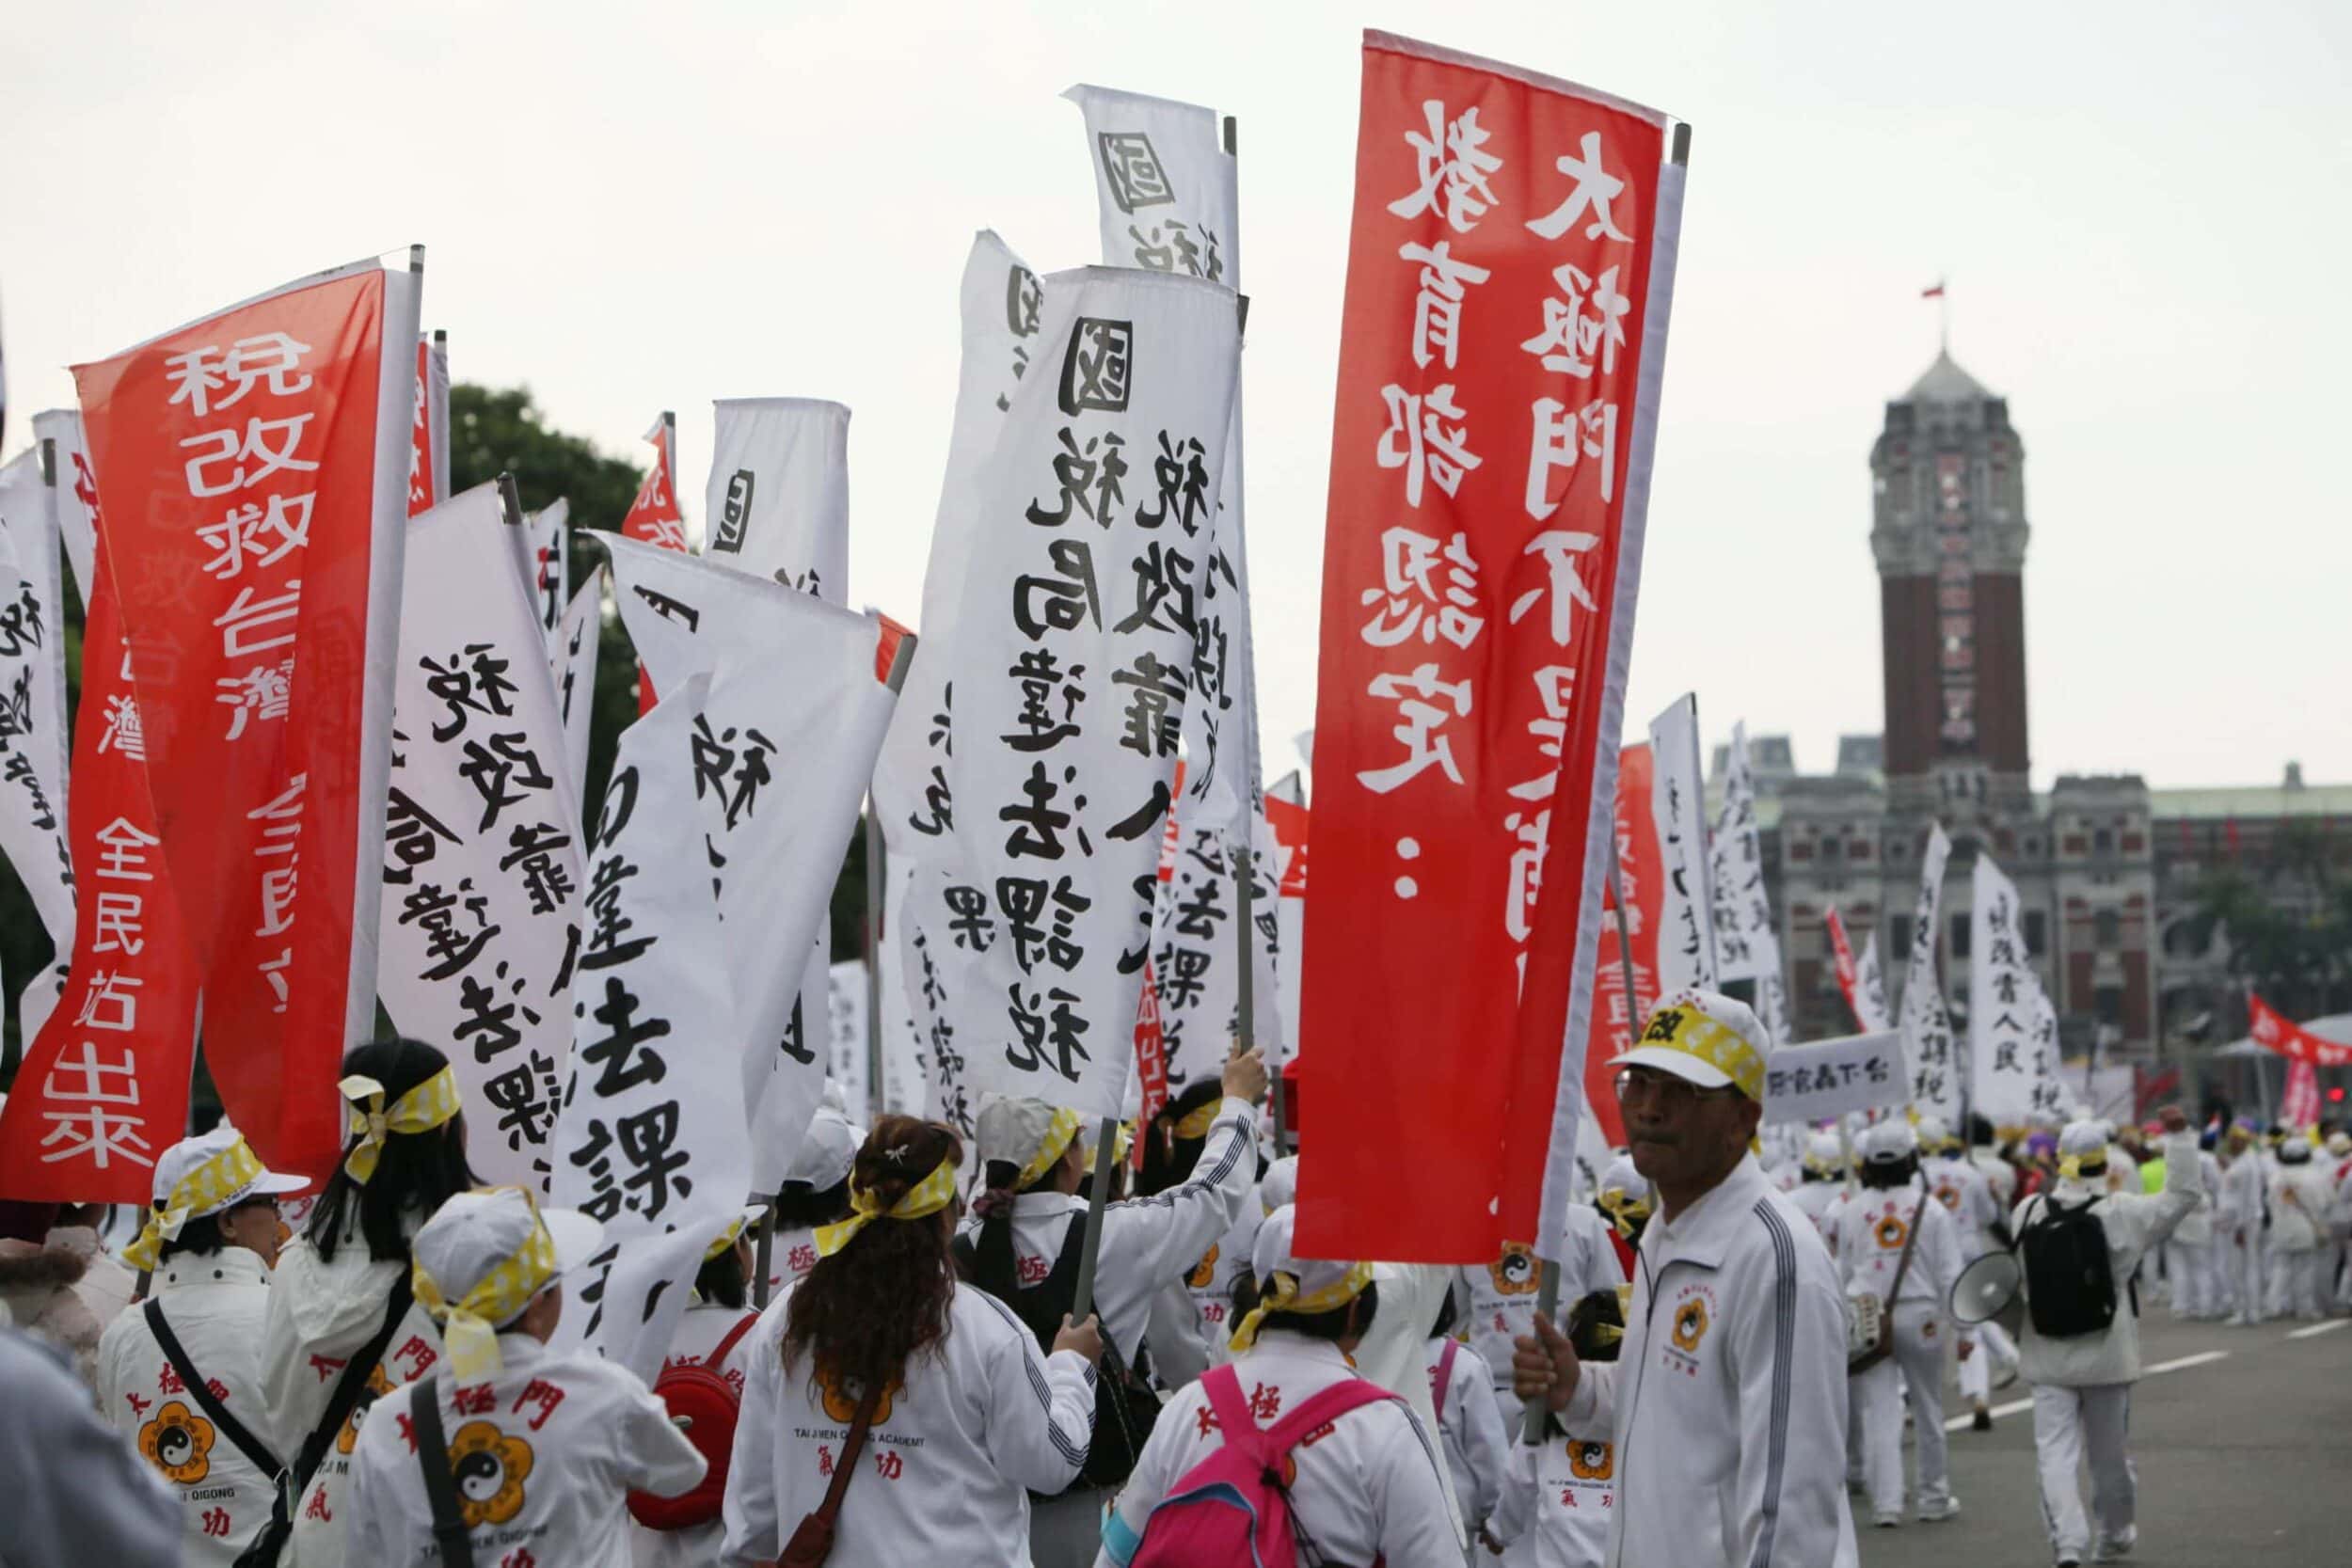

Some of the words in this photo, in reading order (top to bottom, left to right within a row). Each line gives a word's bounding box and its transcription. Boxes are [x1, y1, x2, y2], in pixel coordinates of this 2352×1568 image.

[165, 332, 320, 741] 稅改救台灣
[40, 816, 160, 1169] 全民站出來
[191, 1487, 235, 1502] QIGONG
[201, 1506, 230, 1538] 功
